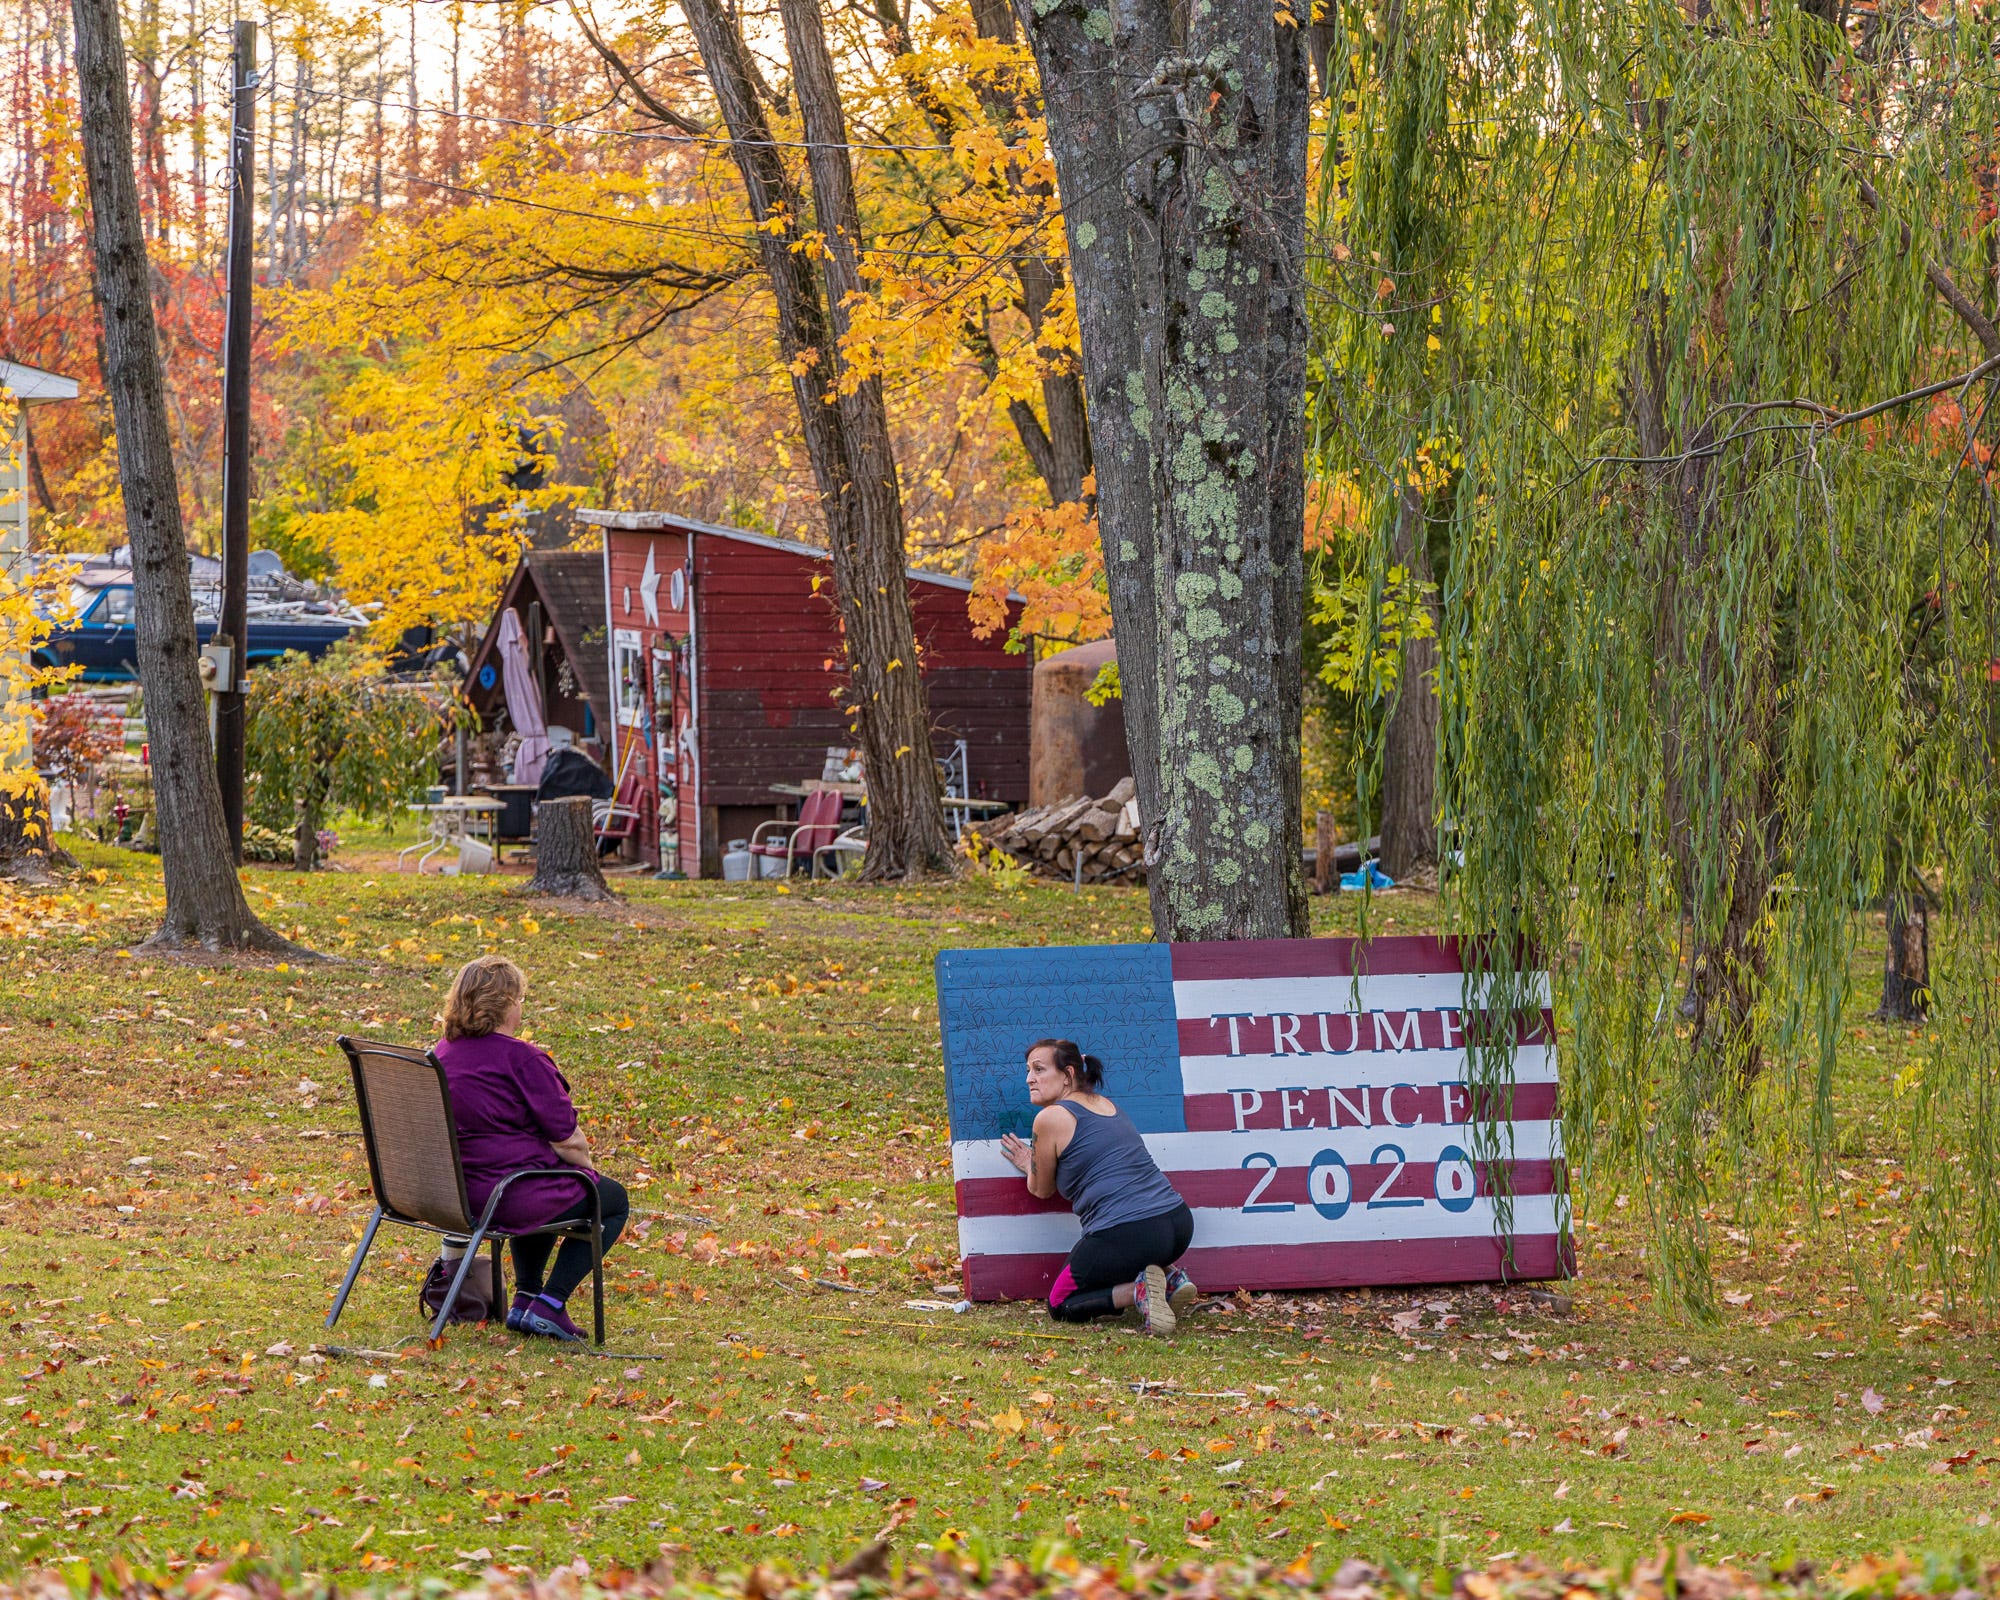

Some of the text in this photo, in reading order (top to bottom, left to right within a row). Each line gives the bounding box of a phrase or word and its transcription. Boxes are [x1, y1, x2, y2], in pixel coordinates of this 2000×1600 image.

[1209, 1006, 1470, 1058] TRUMP
[1227, 1081, 1474, 1133] PENCE
[1241, 1143, 1477, 1221] 2020
